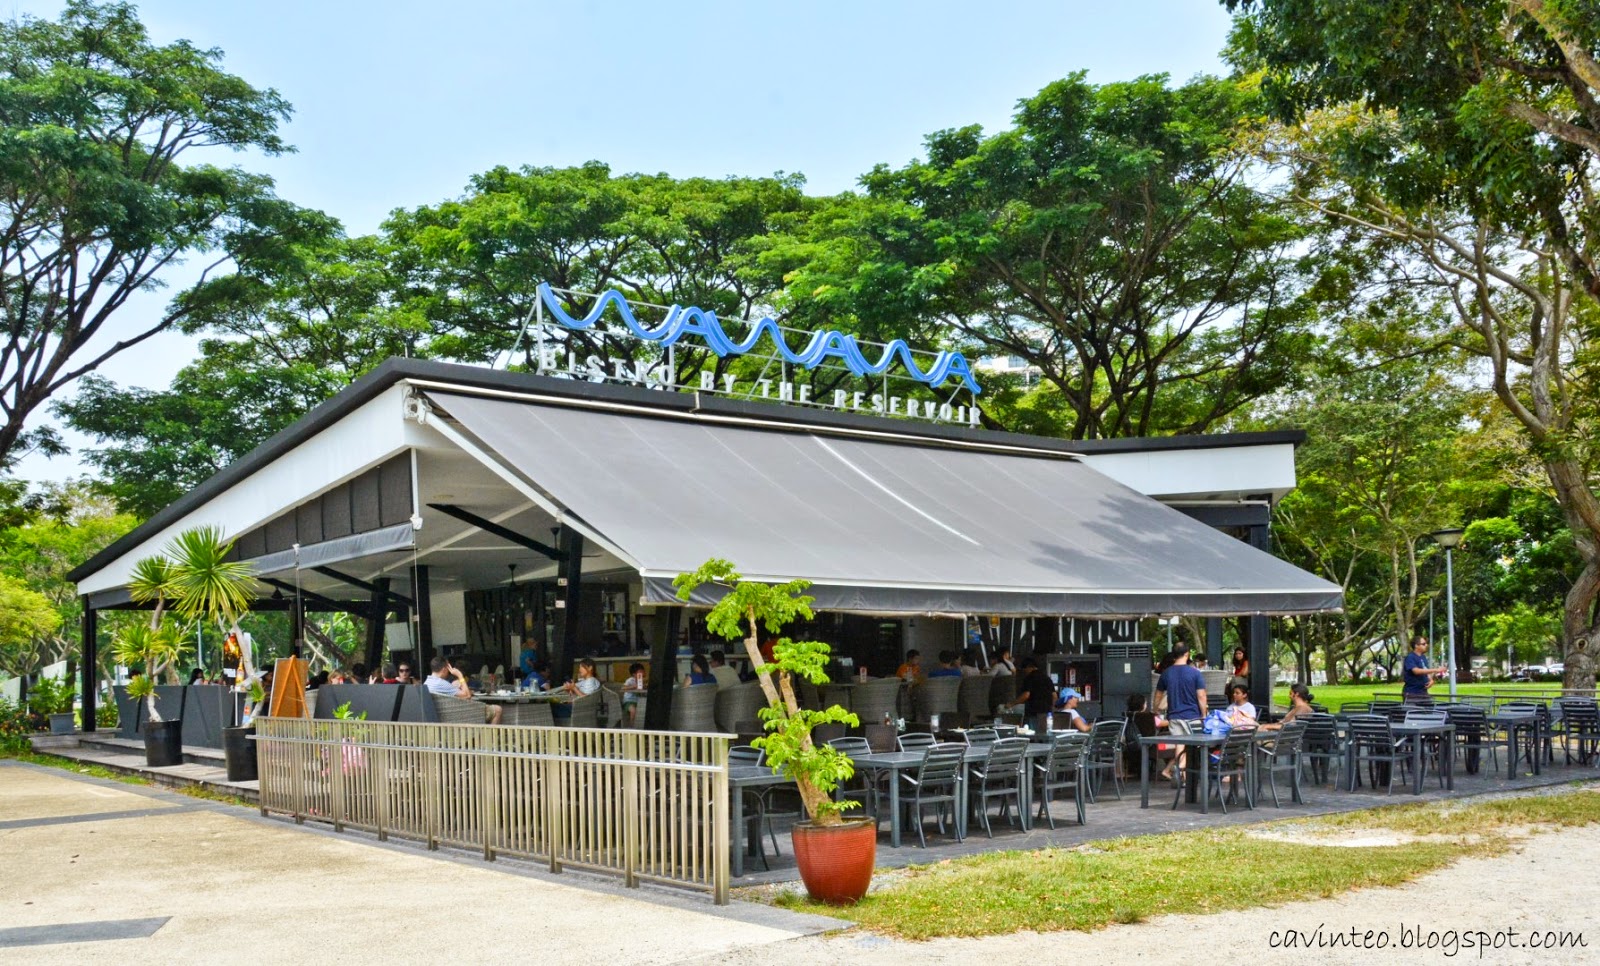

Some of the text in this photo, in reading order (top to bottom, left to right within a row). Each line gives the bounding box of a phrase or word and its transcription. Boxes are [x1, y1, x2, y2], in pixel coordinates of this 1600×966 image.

[541, 351, 981, 425] BISTRO BY THE RESERVOIR
